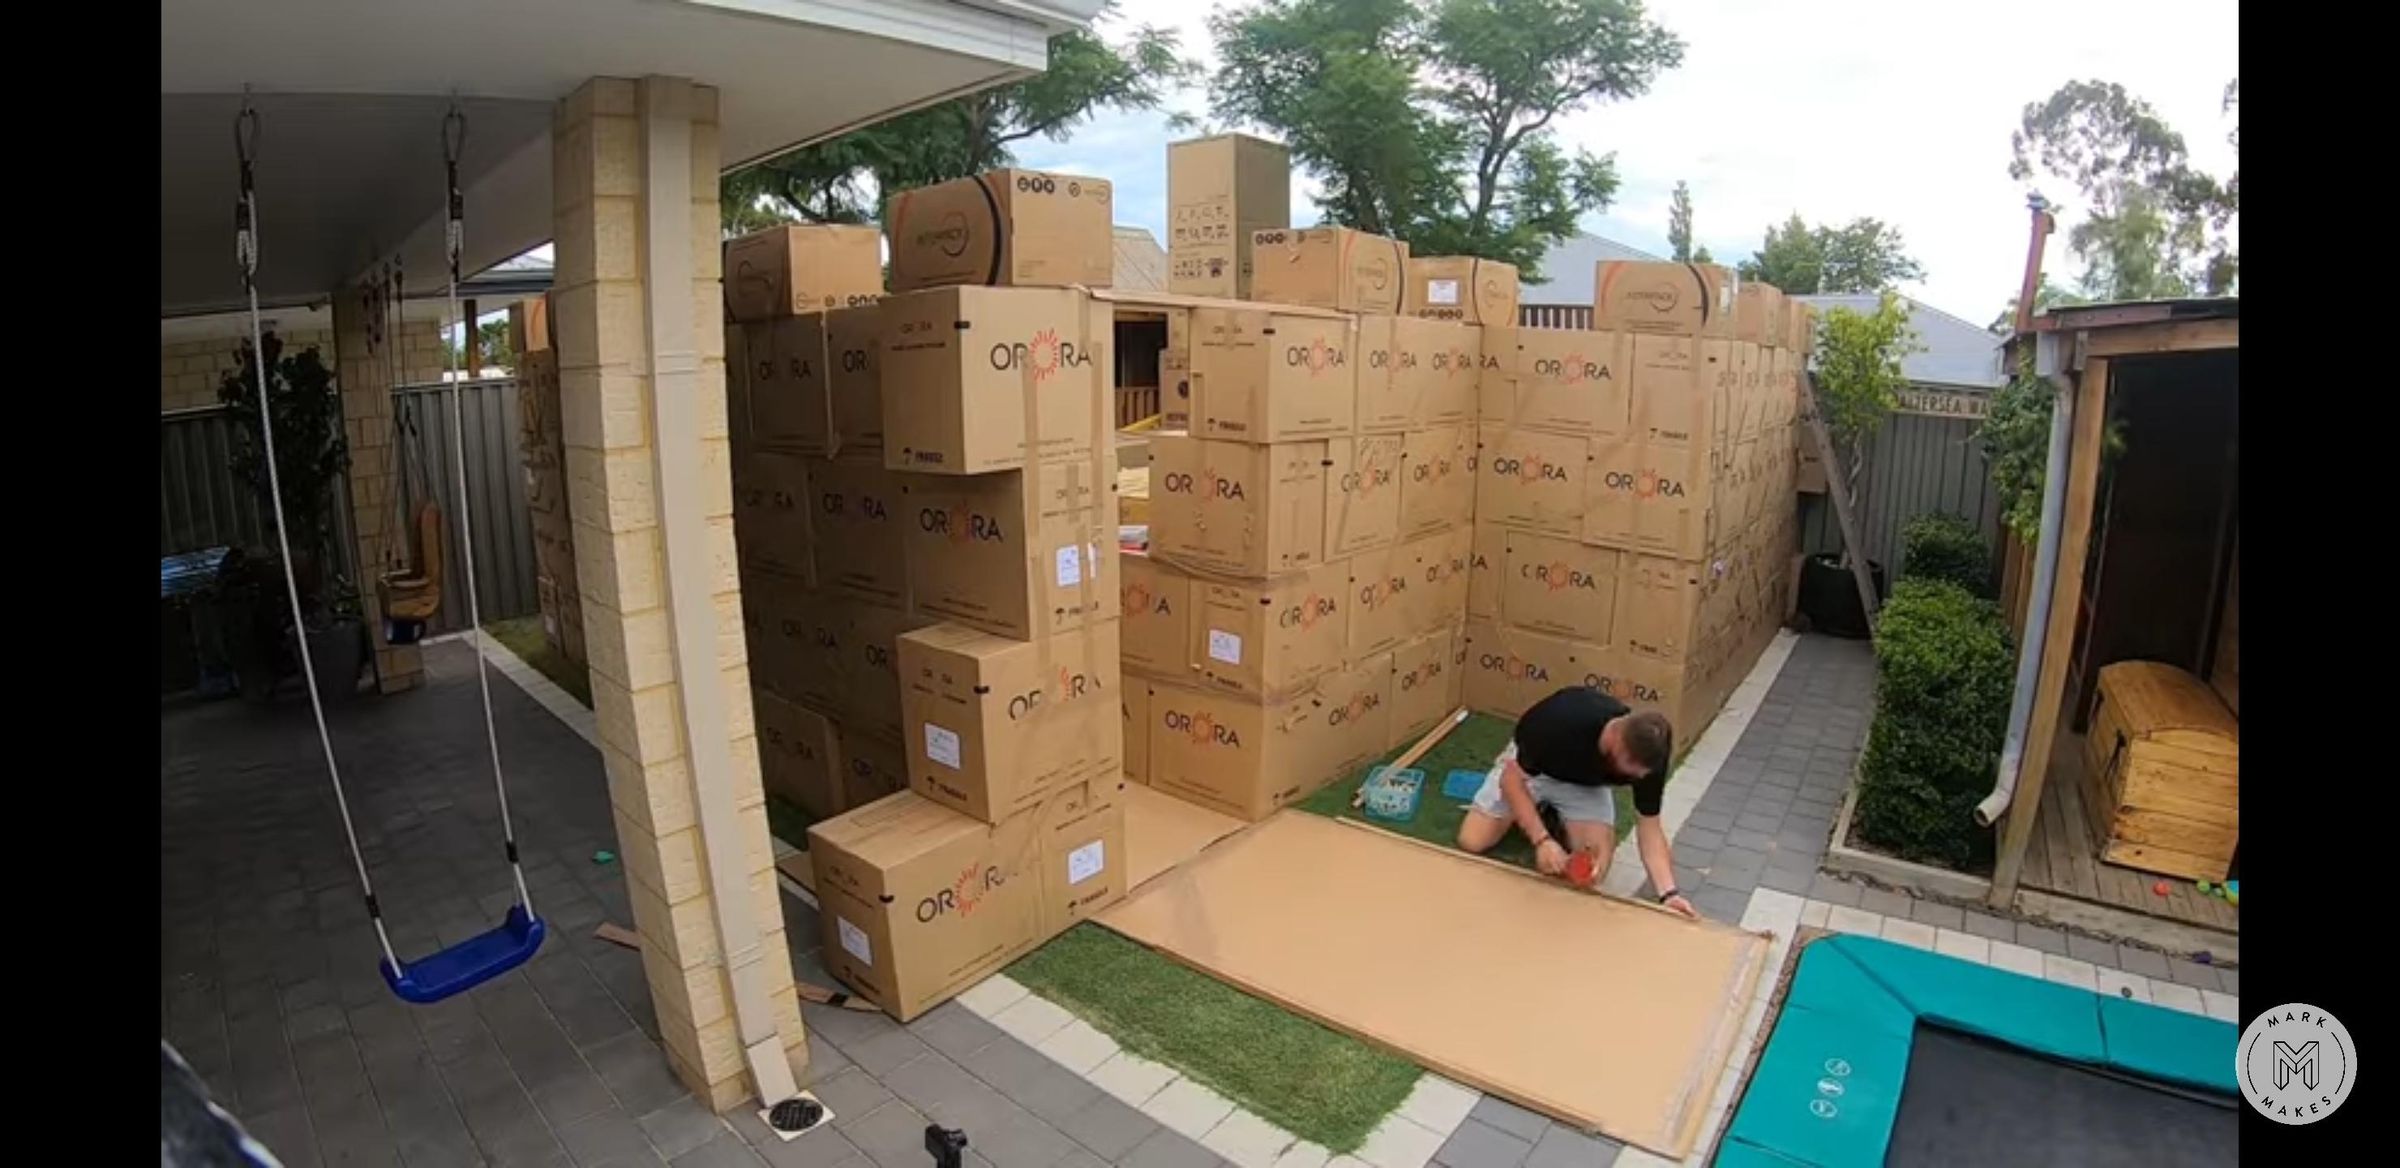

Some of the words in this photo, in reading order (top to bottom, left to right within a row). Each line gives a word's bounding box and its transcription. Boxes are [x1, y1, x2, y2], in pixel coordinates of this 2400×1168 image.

[990, 329, 1093, 380] ORORA
[1288, 334, 1345, 379] ORORA
[1535, 352, 1611, 385] ORORA
[1494, 453, 1567, 486] ORORA
[1605, 468, 1684, 499] ORORA
[1480, 650, 1549, 682] ORORA
[1584, 674, 1660, 704] ORORA
[1165, 711, 1240, 748] ORORA
